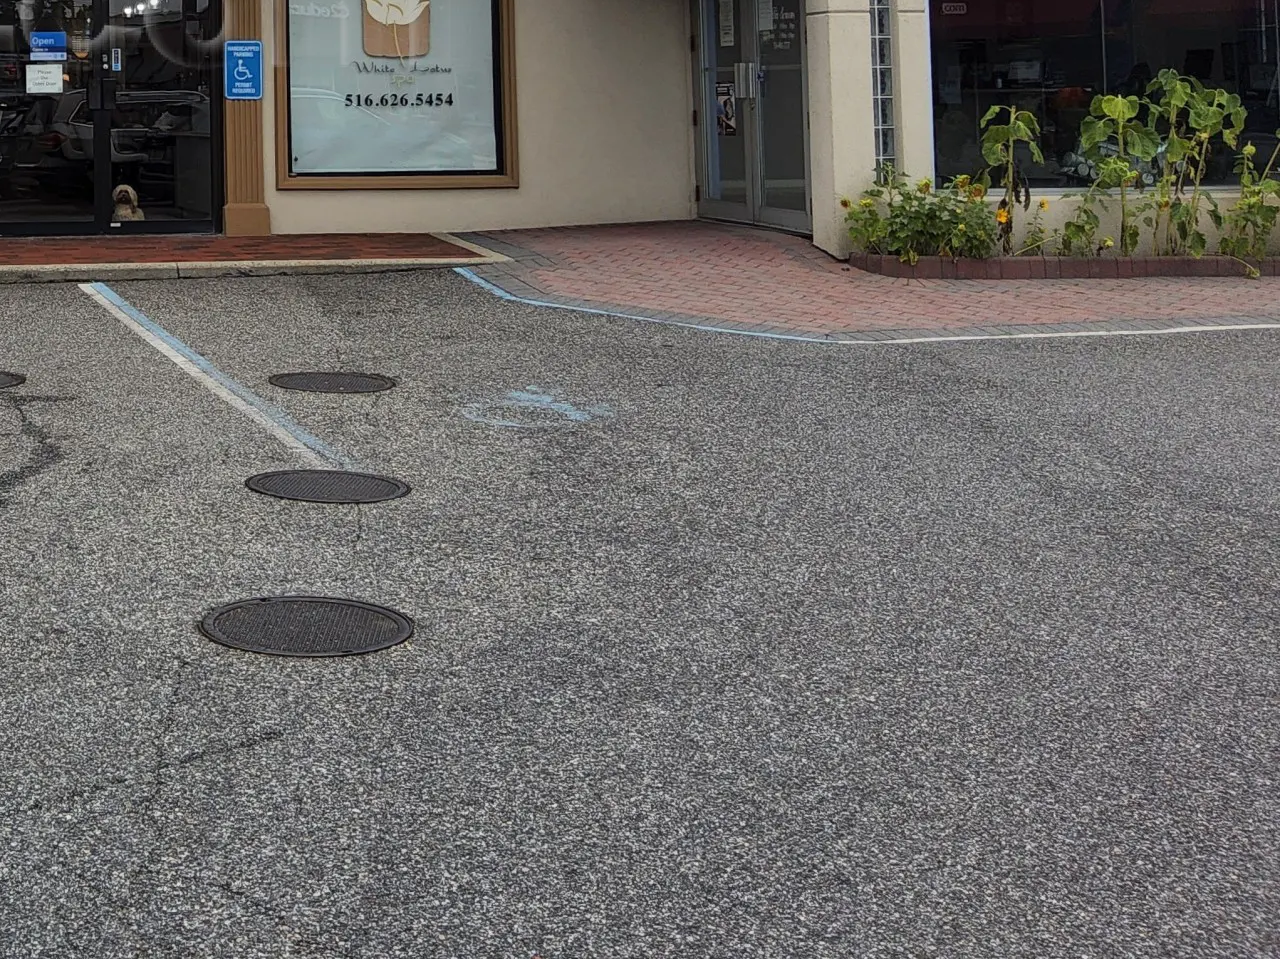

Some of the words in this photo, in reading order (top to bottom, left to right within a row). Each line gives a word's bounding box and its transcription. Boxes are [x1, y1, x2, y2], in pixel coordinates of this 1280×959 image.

[31, 36, 55, 46] Open
[352, 60, 395, 74] White
[410, 61, 453, 74] Lotus
[344, 93, 454, 107] 516.626.5454
